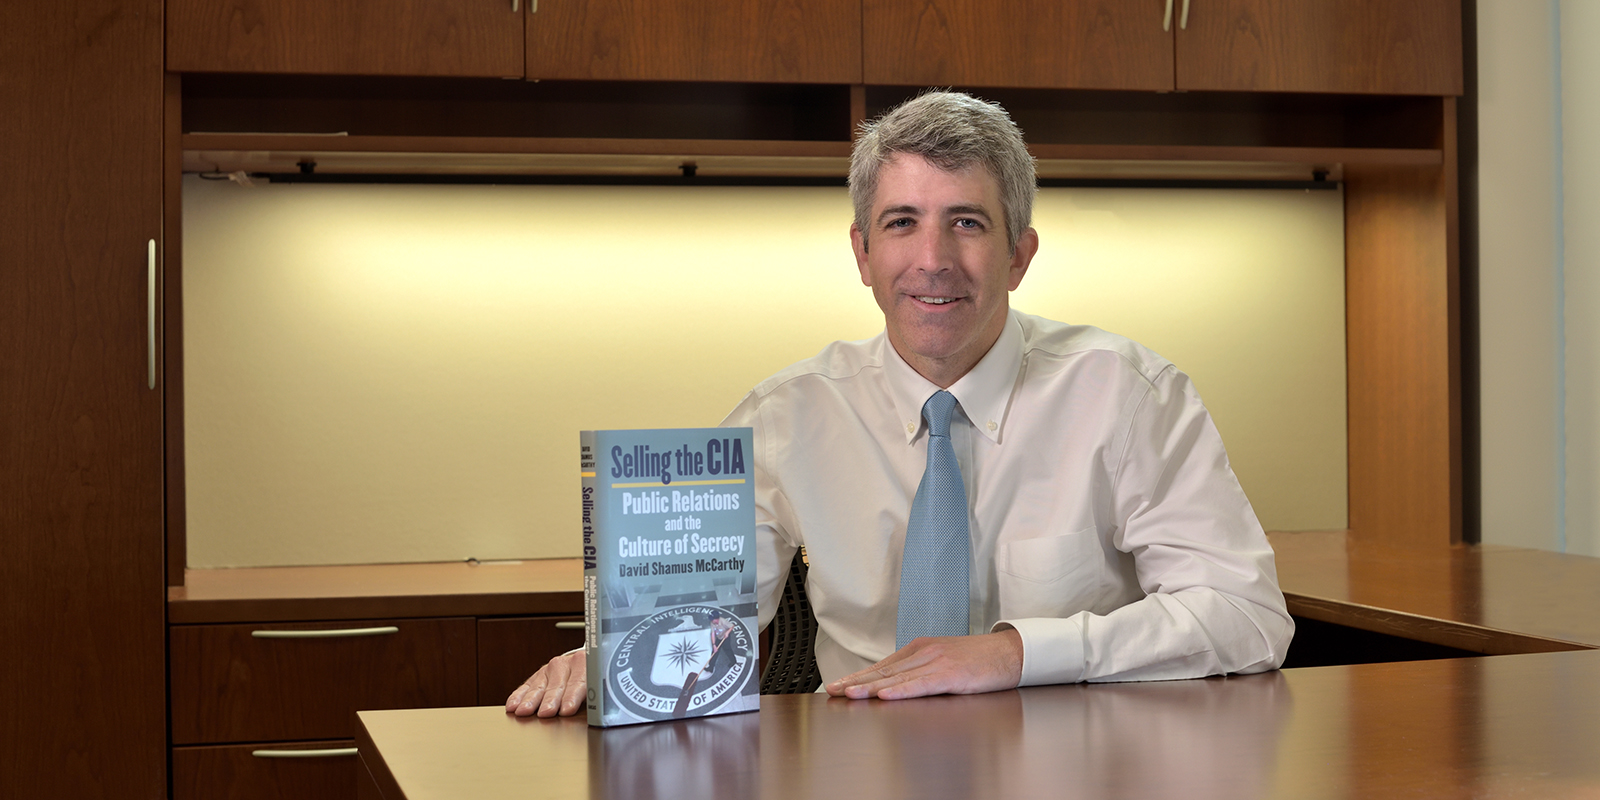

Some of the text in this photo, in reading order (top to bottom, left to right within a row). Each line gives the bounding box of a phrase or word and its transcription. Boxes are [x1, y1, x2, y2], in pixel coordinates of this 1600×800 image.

[611, 438, 745, 485] Selling the CIA
[622, 489, 740, 515] Public Relations
[664, 515, 701, 531] and the
[582, 486, 597, 570] Selling the CIA
[619, 532, 745, 558] Culture of Secrecy
[619, 557, 745, 577] David Shamus McCarthy
[589, 576, 598, 649] Public Relations and
[616, 623, 651, 668] CENTRAL
[650, 606, 722, 625] INTELLIGENC
[621, 660, 744, 711] UNITED STAT OF AMERICA
